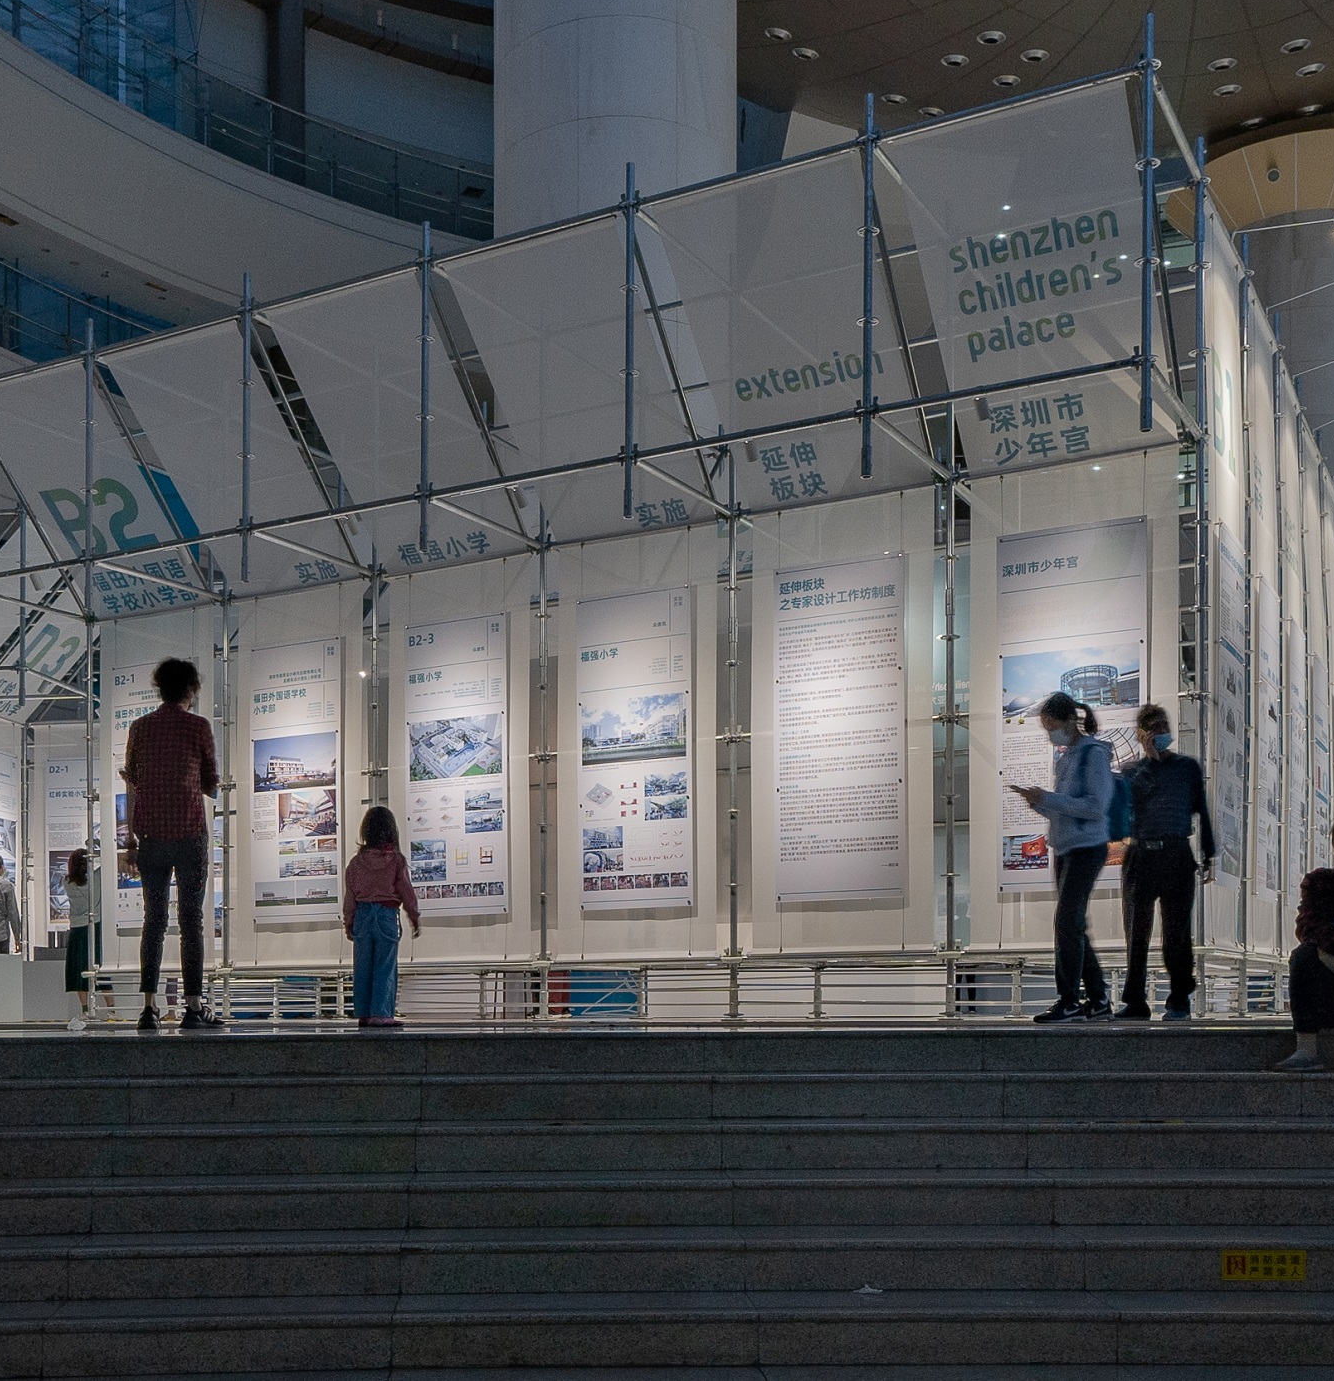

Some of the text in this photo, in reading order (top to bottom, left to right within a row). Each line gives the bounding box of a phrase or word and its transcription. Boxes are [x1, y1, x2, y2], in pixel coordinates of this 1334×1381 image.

[949, 210, 1119, 273] shenzhen
[958, 250, 1123, 315] children's
[967, 311, 1076, 362] palace
[735, 350, 884, 402] extension
[989, 393, 1084, 434] 深圳市
[760, 441, 817, 474] 延伸
[994, 426, 1091, 466] 少年宫
[770, 471, 829, 503] 板块
[38, 478, 160, 556] B2
[634, 498, 690, 527] 实施
[398, 531, 490, 566] 福强小学
[92, 559, 187, 592] 福田外国语
[294, 559, 340, 584] 实施
[1002, 556, 1079, 577] 深圳市少年宫
[103, 581, 199, 614] 学校小学部
[779, 578, 825, 595] 延伸板块
[779, 584, 896, 611] 之专家设计工作坊制度
[409, 633, 434, 647] B2-3
[581, 647, 618, 663] 福强小学
[114, 674, 136, 687] B2-1
[409, 671, 442, 684] 福强小学
[253, 688, 307, 704] 福田外国语学校
[49, 765, 69, 774] D2-1
